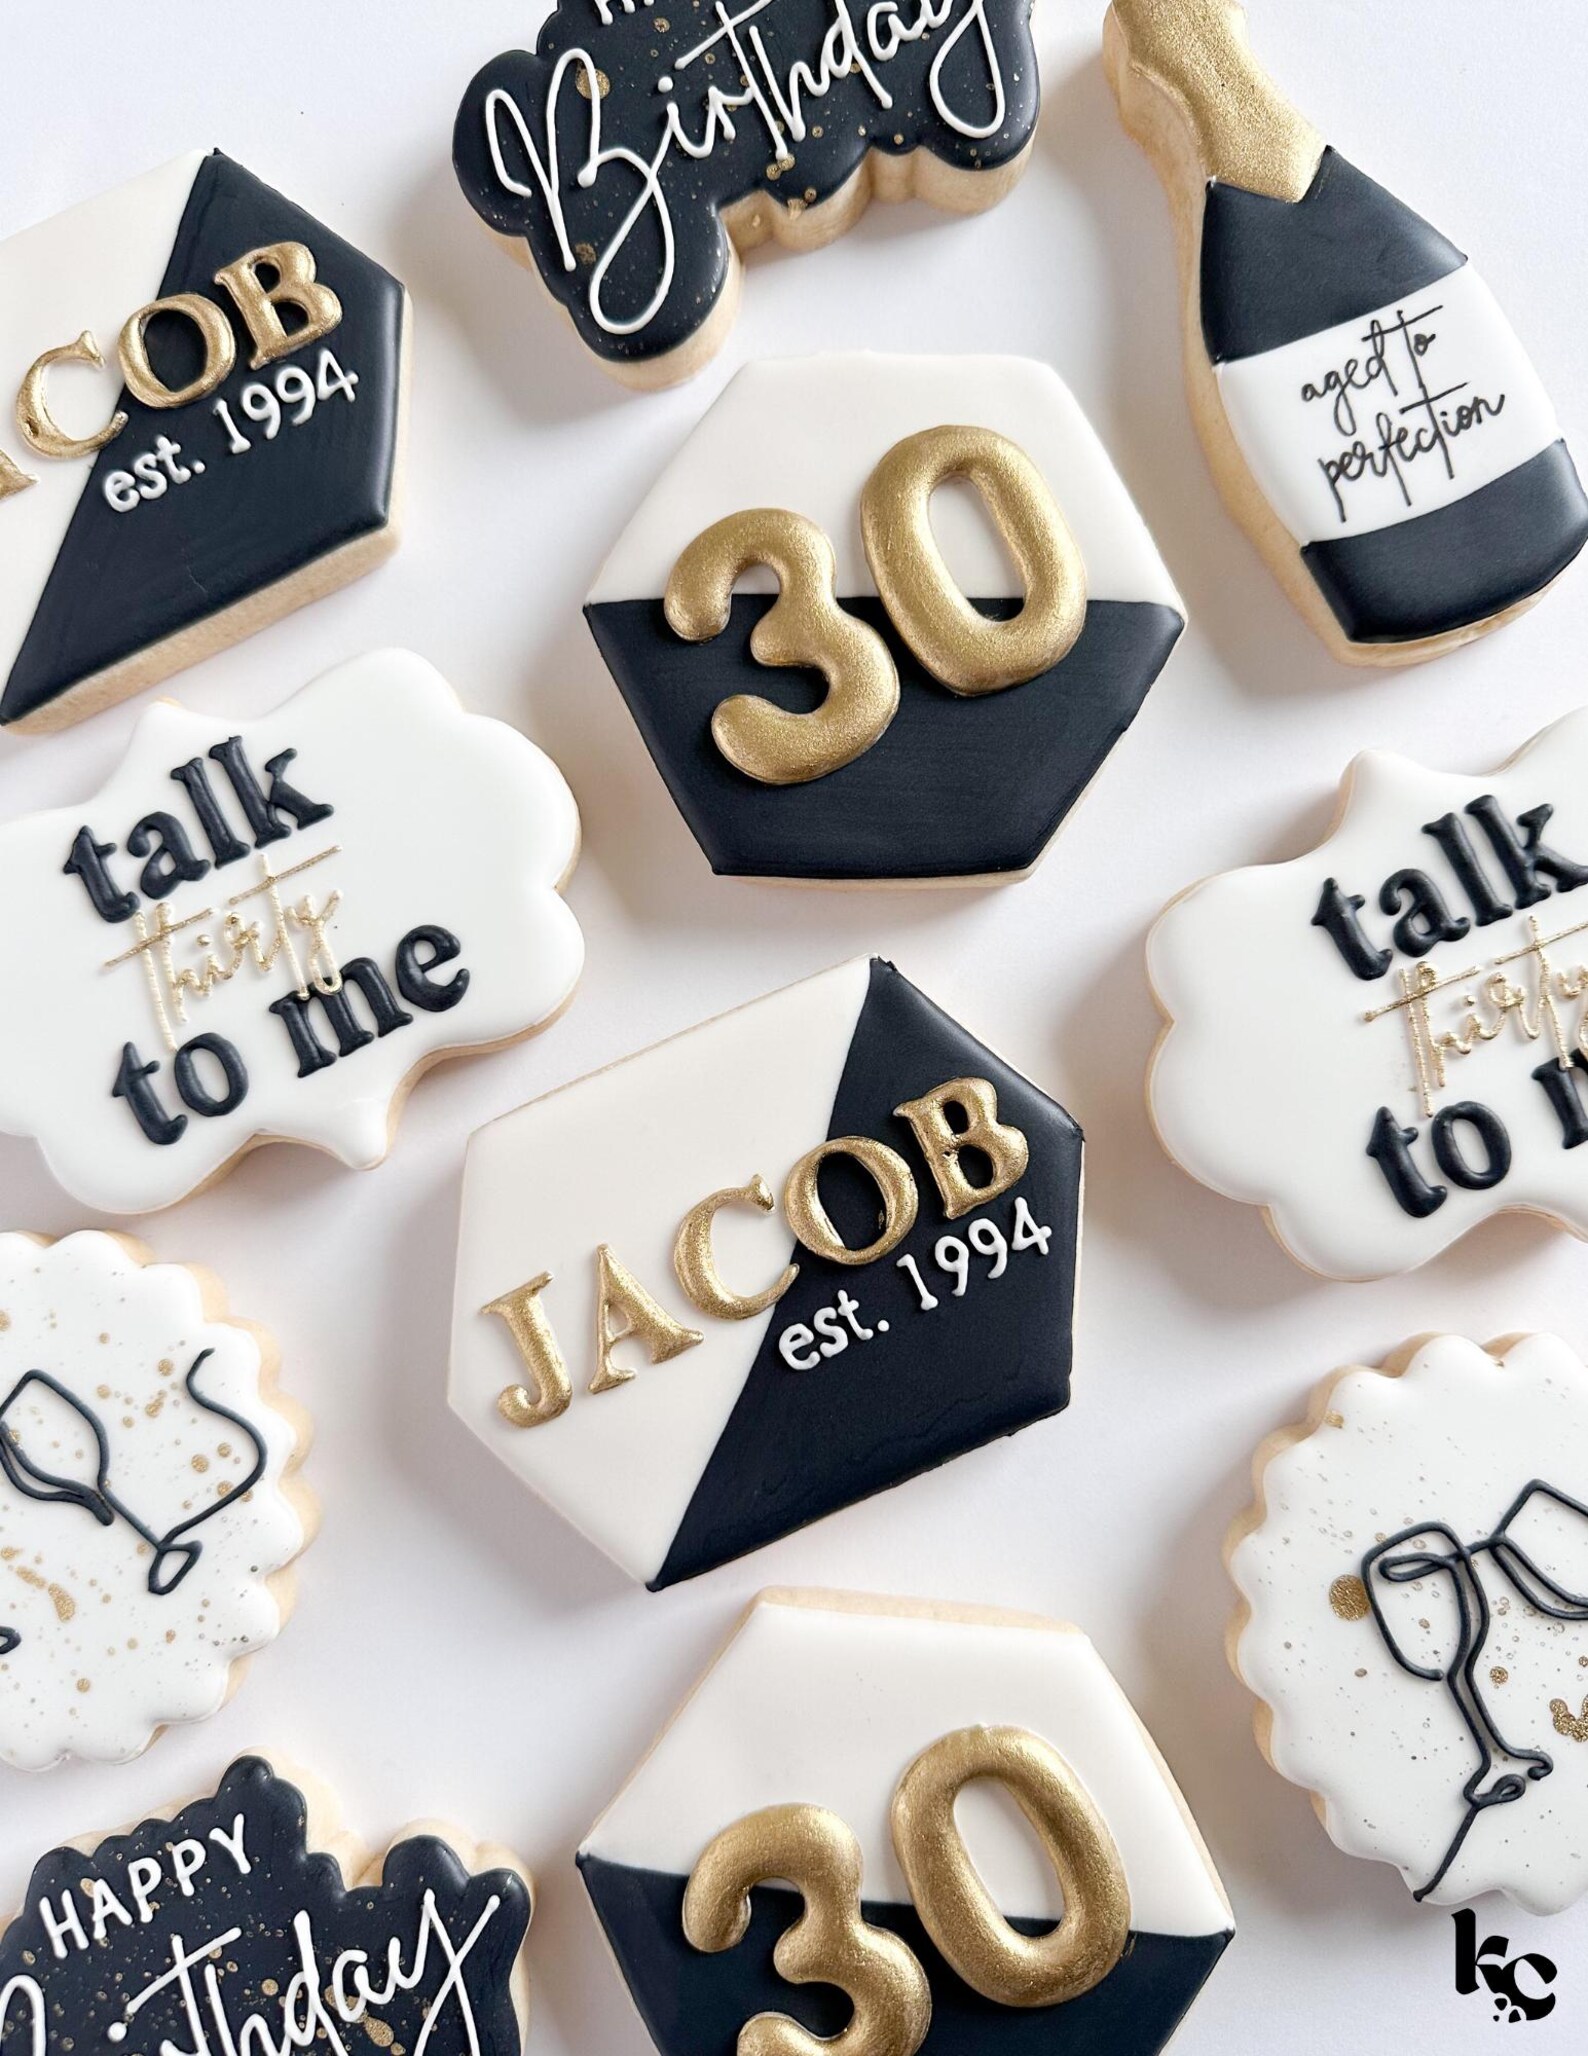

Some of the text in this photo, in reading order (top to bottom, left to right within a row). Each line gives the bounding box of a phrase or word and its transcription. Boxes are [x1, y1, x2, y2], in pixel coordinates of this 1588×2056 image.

[486, 0, 1004, 334] Birthday
[104, 348, 359, 512] est. 1994
[1301, 305, 1444, 436] aged to
[1317, 382, 1505, 523] perfection
[663, 424, 1087, 785] 30
[62, 736, 335, 923] talk
[1311, 794, 1588, 981] talk
[104, 845, 343, 1051] thirty
[111, 924, 470, 1145] to me
[480, 1077, 1029, 1427] JACOB
[1366, 1101, 1512, 1218] to
[778, 1197, 1053, 1371] est. 1994
[0, 1888, 501, 2056] thday
[38, 1813, 251, 1959] HAPPY
[682, 1723, 1132, 2056] 30
